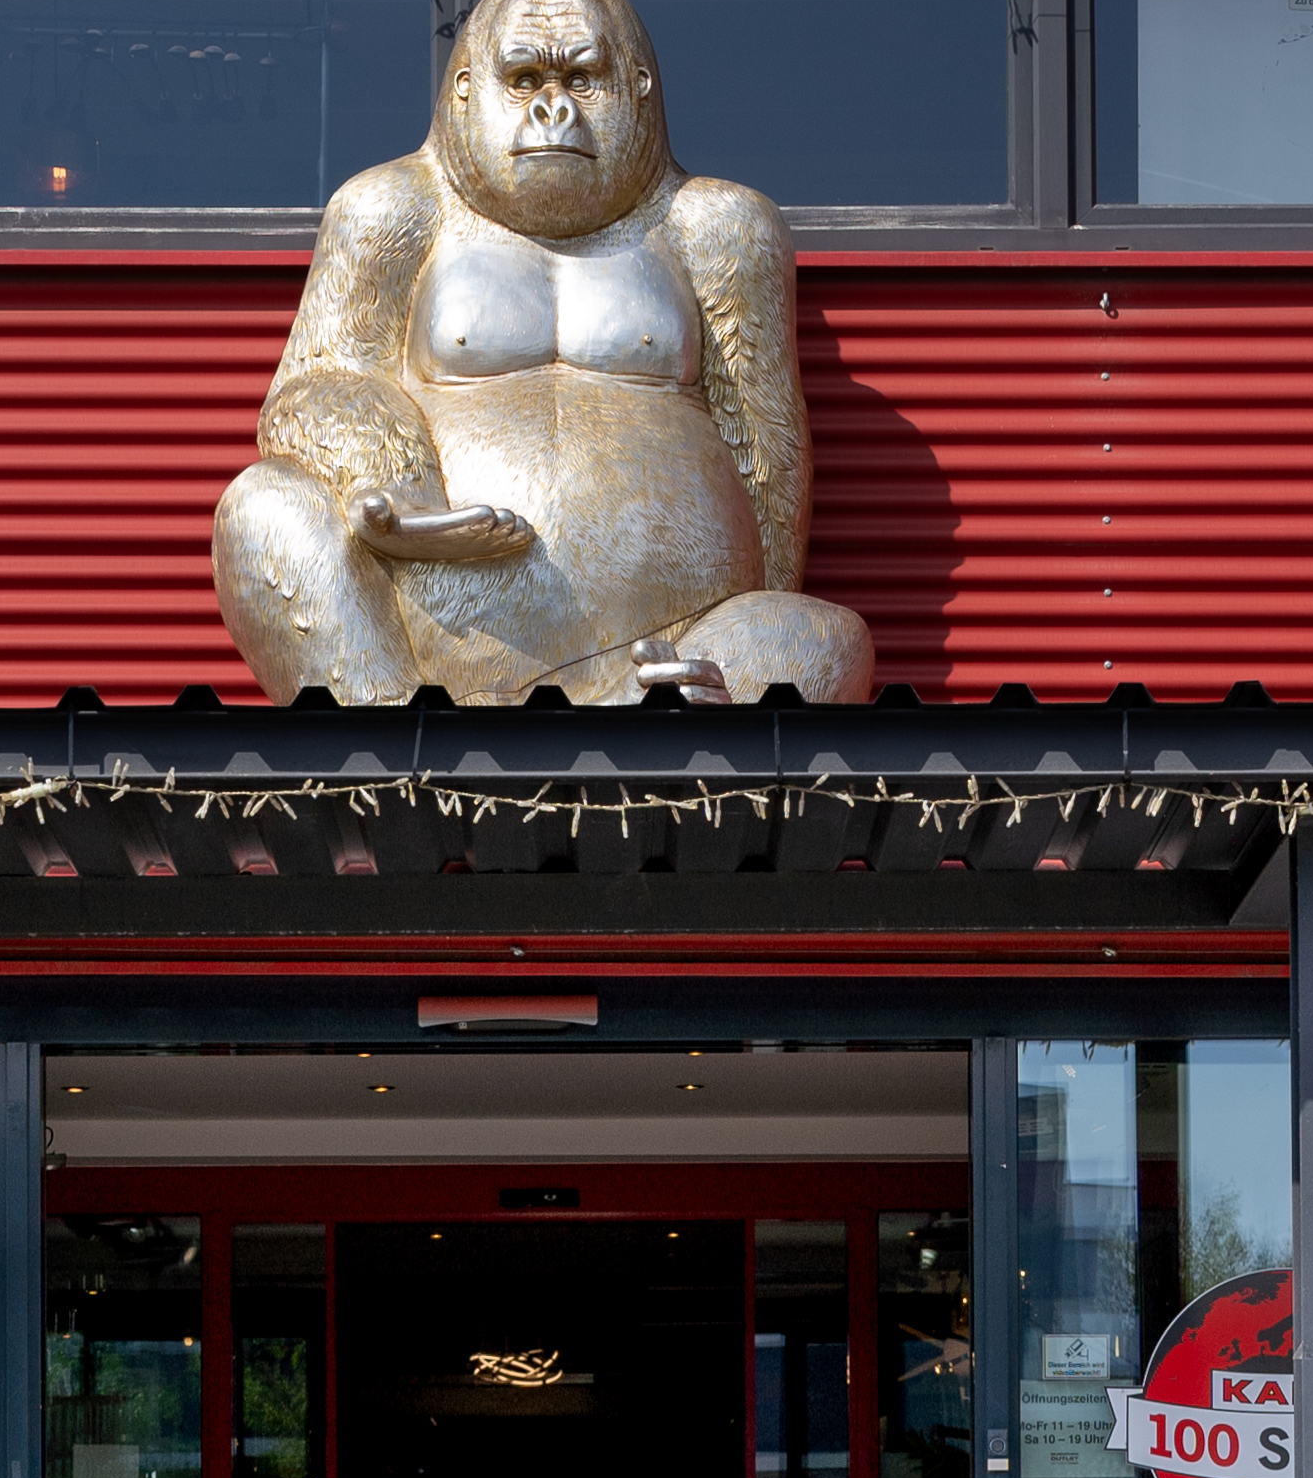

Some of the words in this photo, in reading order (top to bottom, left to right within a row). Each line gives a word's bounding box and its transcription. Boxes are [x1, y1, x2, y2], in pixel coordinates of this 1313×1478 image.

[1022, 1392, 1106, 1405] Öffnungszeiten
[1223, 1378, 1294, 1406] KA
[1052, 1422, 1063, 1430] 11
[1078, 1422, 1090, 1430] 19
[1025, 1435, 1038, 1444] Sa
[1043, 1435, 1056, 1444] 10
[1069, 1435, 1081, 1444] 19
[1085, 1435, 1105, 1444] Uhr
[1149, 1413, 1239, 1467] 100
